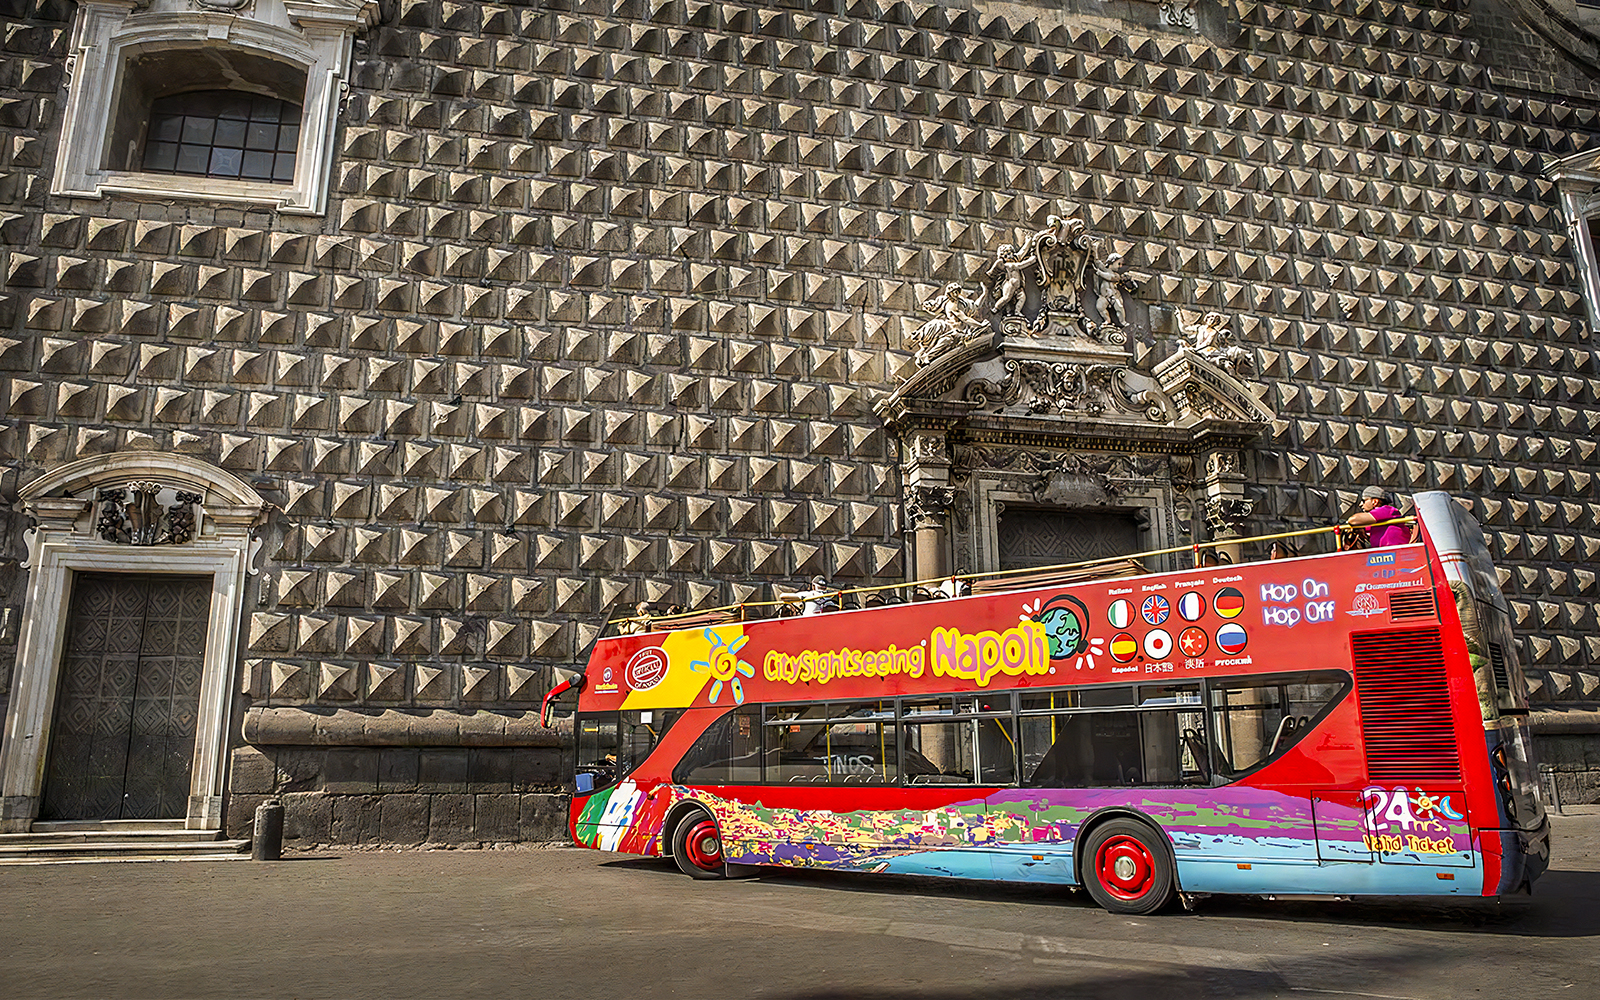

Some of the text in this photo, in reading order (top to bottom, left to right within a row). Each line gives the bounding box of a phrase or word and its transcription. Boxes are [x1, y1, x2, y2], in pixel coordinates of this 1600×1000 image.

[1369, 554, 1394, 564] anm
[1141, 583, 1167, 592] English
[1212, 575, 1243, 584] Deutsch
[1261, 578, 1329, 603] Hop On
[1264, 600, 1335, 627] Hop Off
[931, 619, 1050, 686] Napoli
[1362, 786, 1415, 831] 24
[1362, 834, 1458, 856] Valid Ticket
